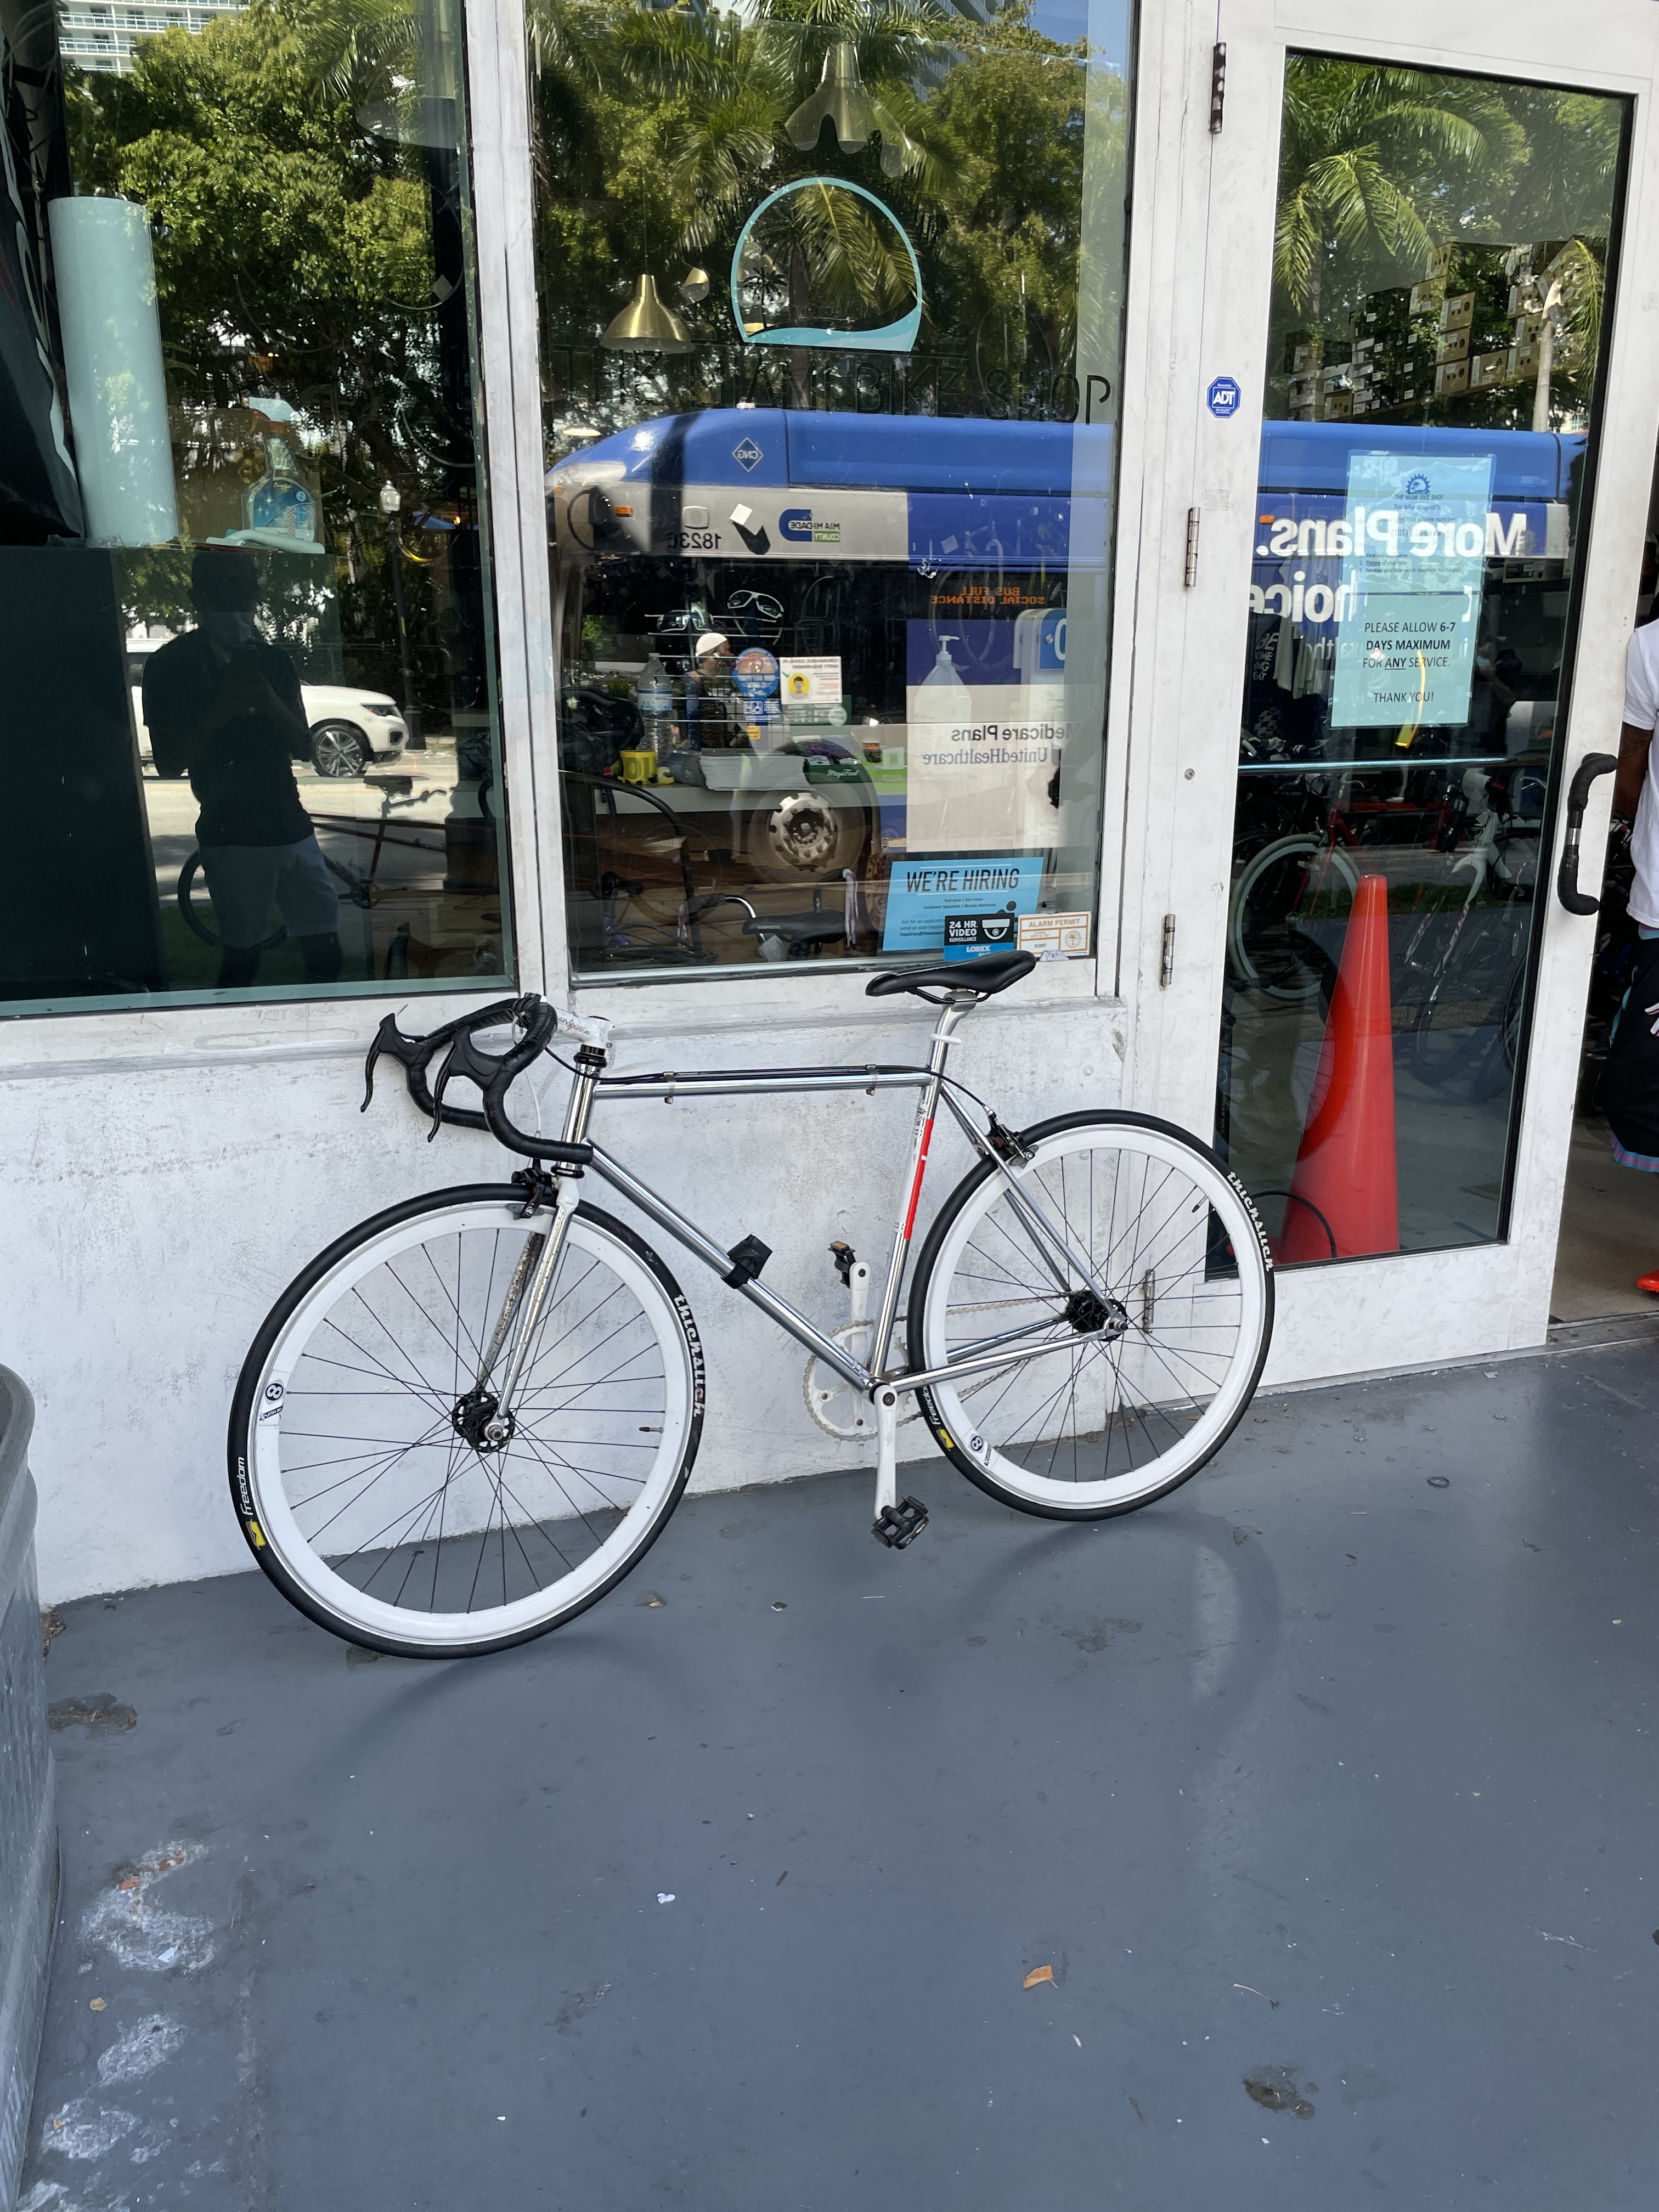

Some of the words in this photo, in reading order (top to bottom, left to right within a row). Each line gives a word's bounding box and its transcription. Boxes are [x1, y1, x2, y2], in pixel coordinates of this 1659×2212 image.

[856, 361, 967, 417] BIKE
[983, 369, 1111, 426] SHOP
[1212, 390, 1235, 405] ADT
[1391, 529, 1408, 538] (305)
[1364, 622, 1400, 633] PLEASE
[1401, 622, 1437, 633] ALLOW
[1440, 622, 1456, 632] 6-7
[1366, 640, 1392, 651] DAYS
[1395, 640, 1451, 650] MAXIMUM
[1363, 658, 1383, 668] FOR
[1384, 658, 1407, 668] ANY
[1408, 657, 1451, 668] SERVICE.
[1373, 692, 1407, 703] THANK
[1409, 691, 1434, 702] YOU!
[906, 870, 960, 893] WE'RE
[962, 868, 1020, 891] HIRING
[949, 921, 962, 929] 24
[963, 920, 978, 928] HR.
[1029, 919, 1053, 928] ALARM
[1054, 918, 1080, 927] PERMIT
[949, 928, 977, 937] VIDEO
[966, 945, 991, 953] LOREX
[922, 1386, 941, 1425] freedo
